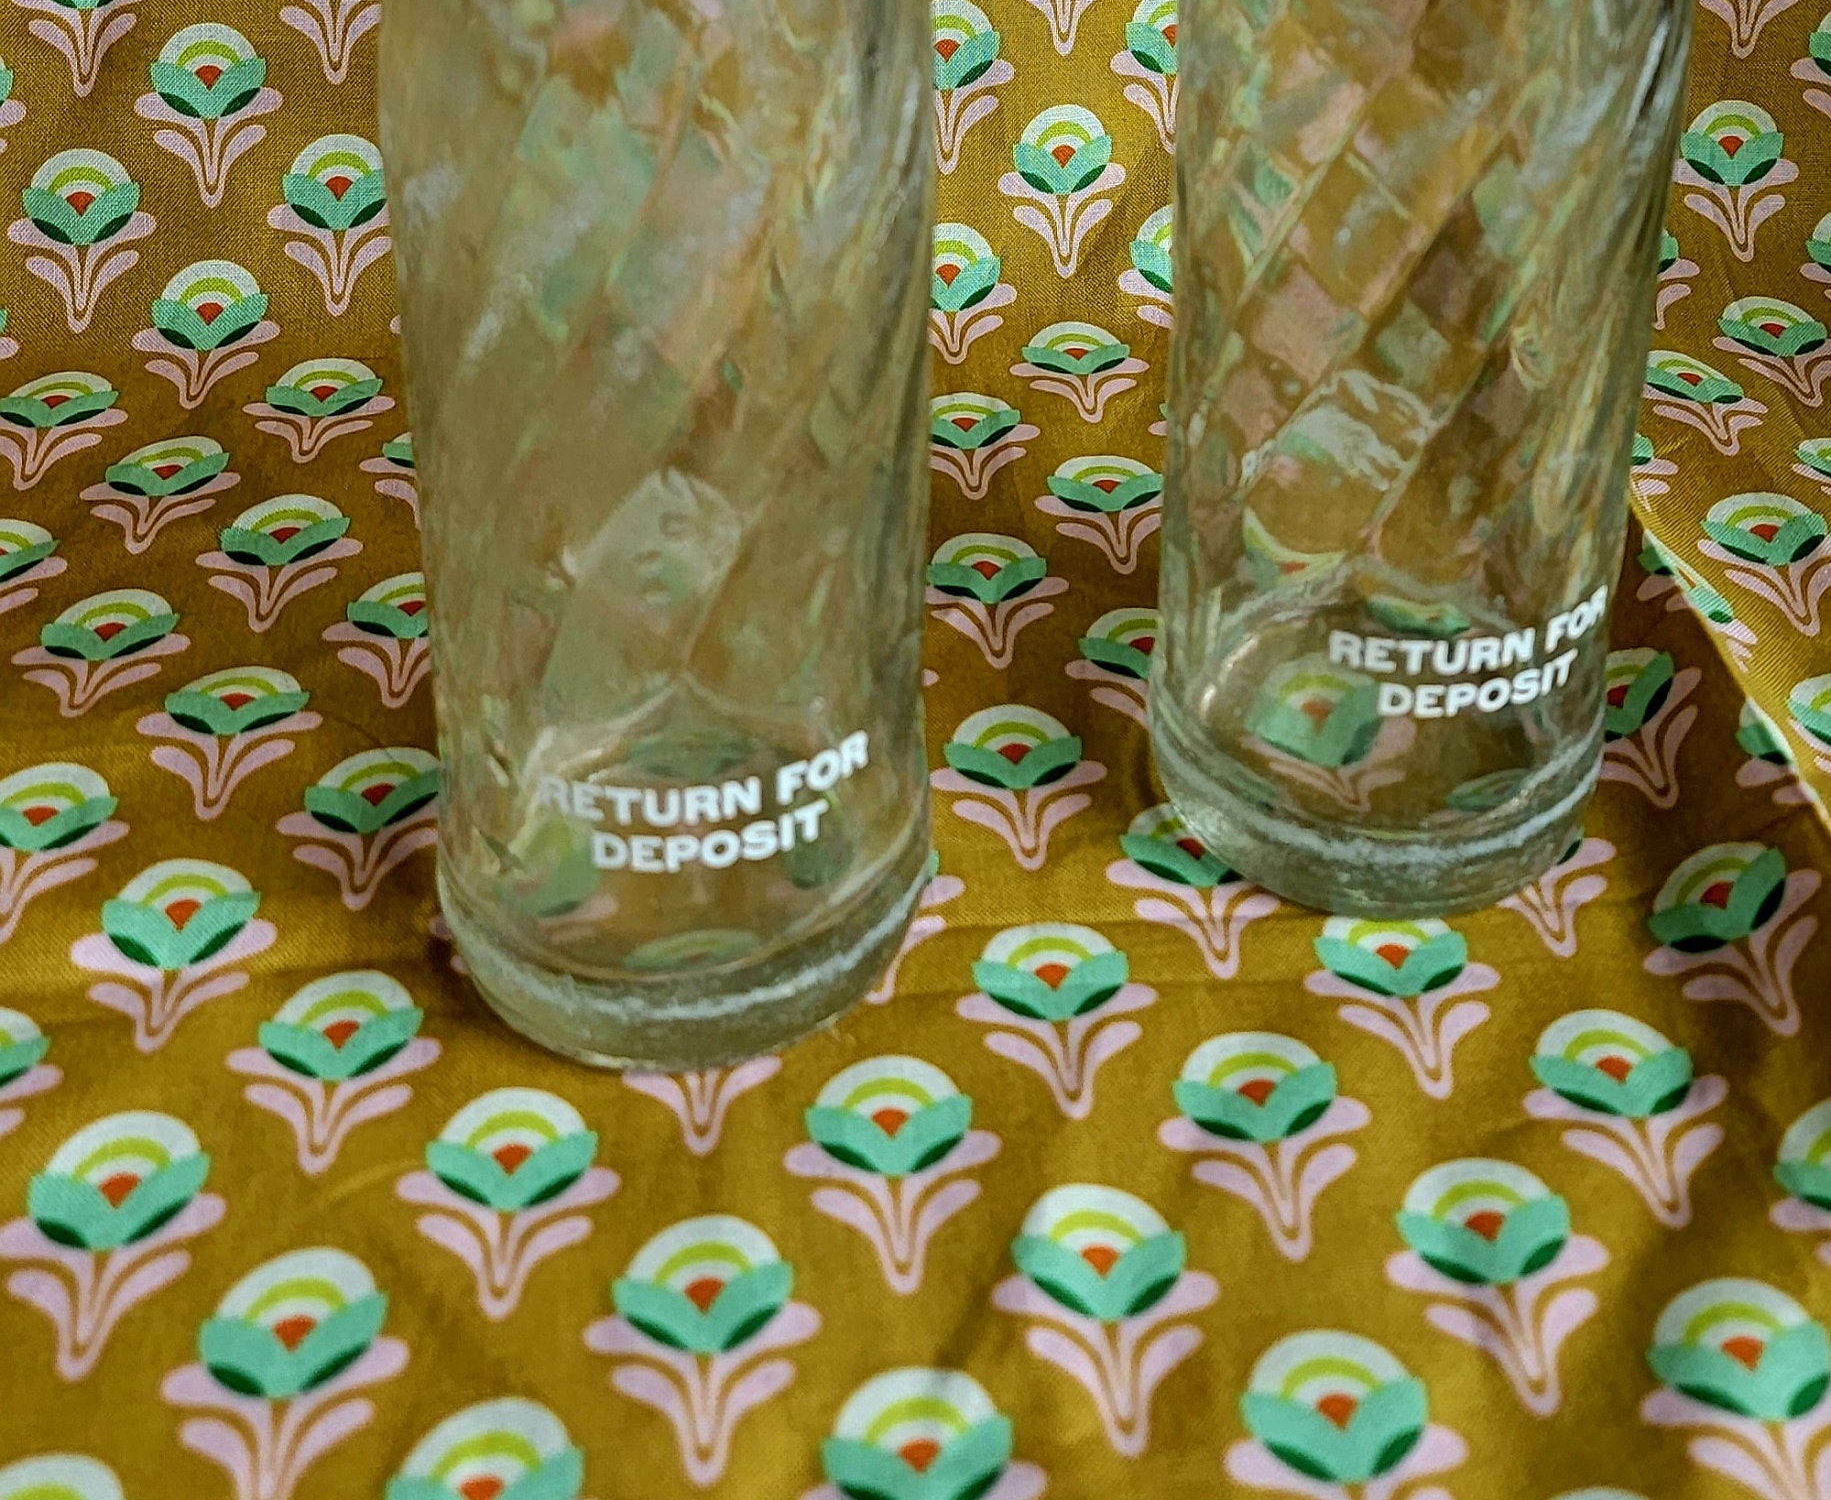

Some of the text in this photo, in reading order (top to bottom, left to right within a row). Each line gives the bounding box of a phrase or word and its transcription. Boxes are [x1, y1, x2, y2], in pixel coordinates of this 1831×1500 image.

[1328, 584, 1608, 675] RETURN FOR
[1377, 647, 1579, 719] DEPOSIT
[536, 729, 870, 828] RETURN FOR
[590, 799, 829, 873] DEPOSIT
